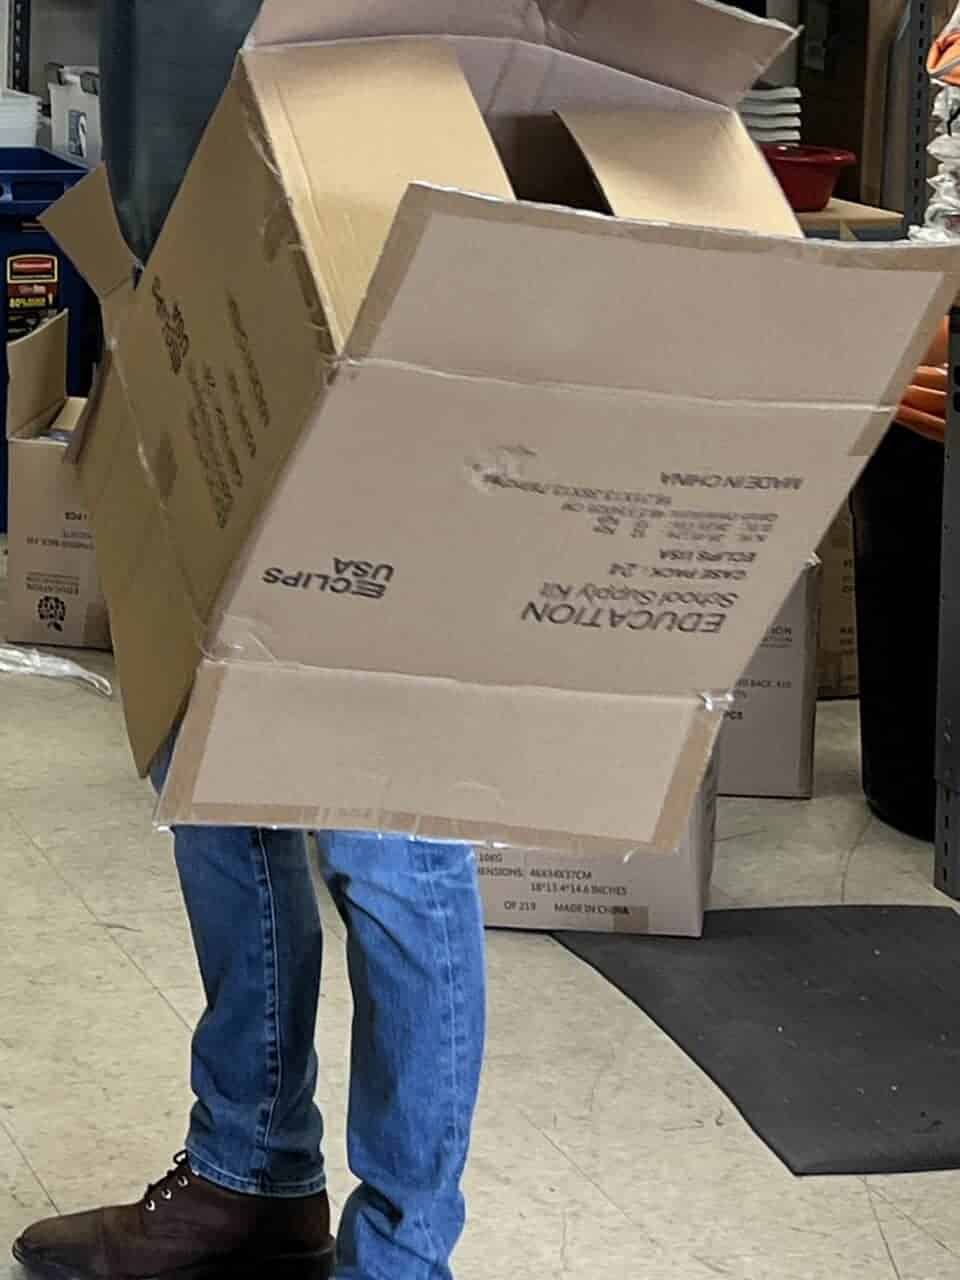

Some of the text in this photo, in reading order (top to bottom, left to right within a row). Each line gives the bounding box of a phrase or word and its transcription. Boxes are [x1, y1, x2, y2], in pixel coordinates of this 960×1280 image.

[333, 557, 394, 582] USA
[262, 567, 387, 600] ECLIPS
[578, 583, 658, 606] Supply
[657, 590, 739, 608] School
[521, 601, 727, 634] EDUCATION
